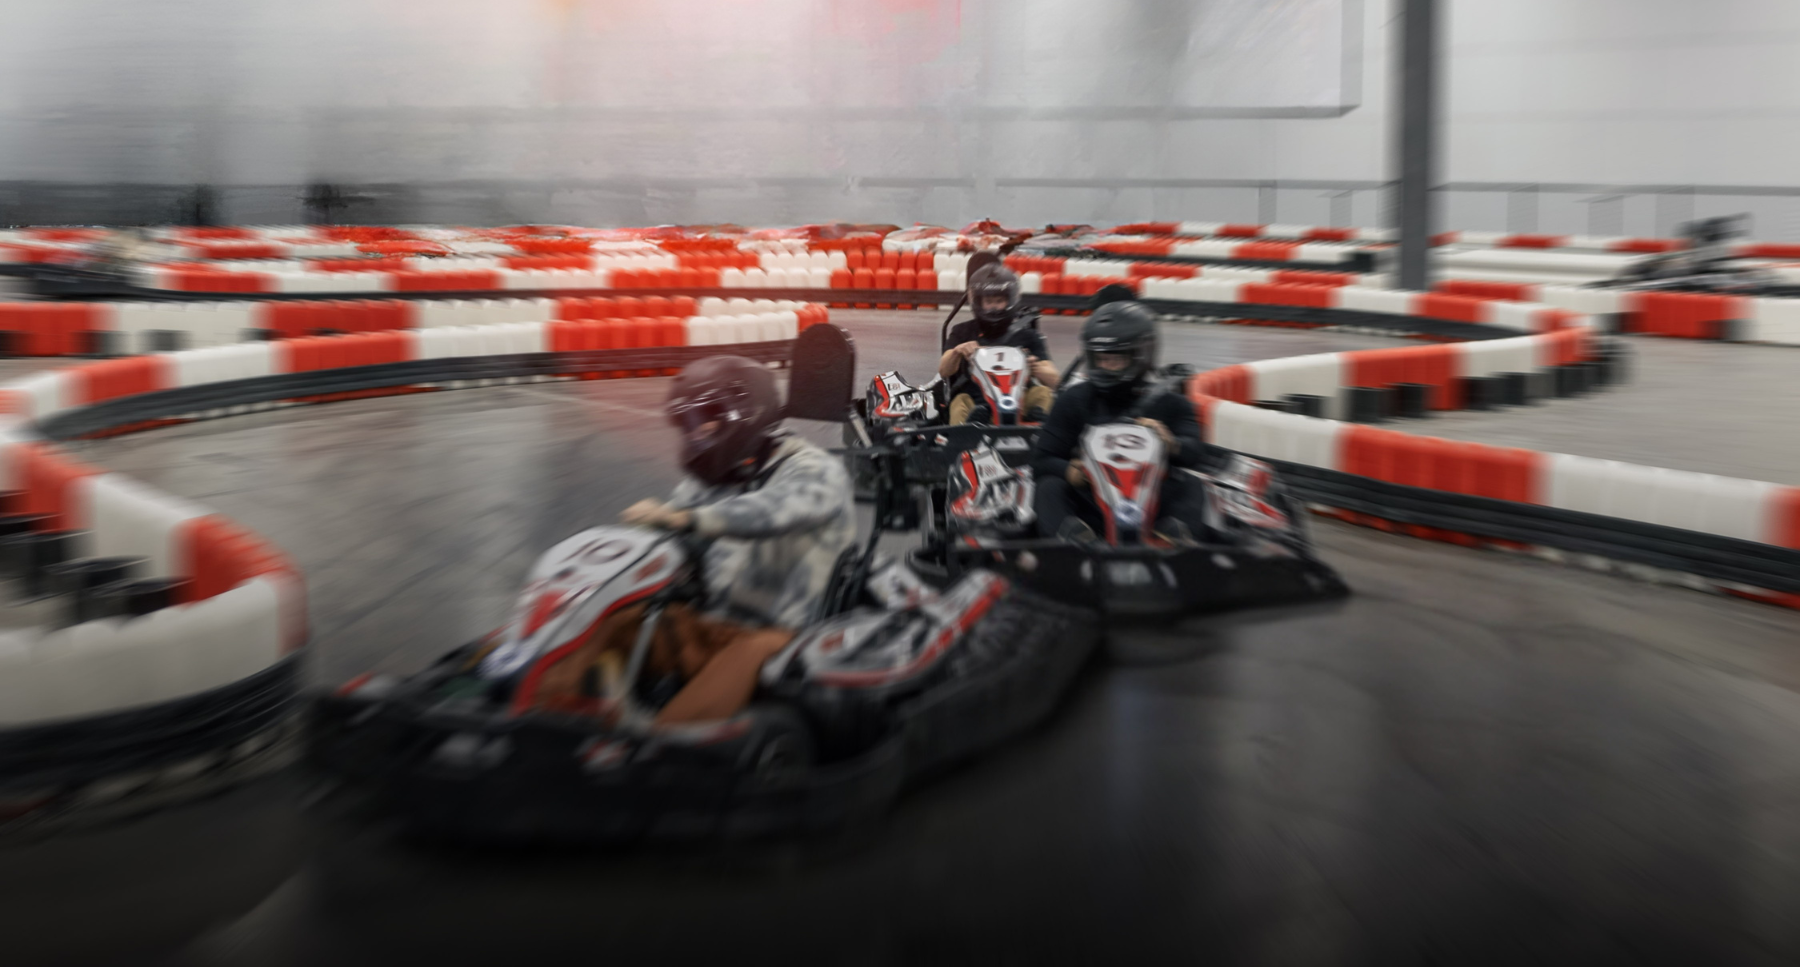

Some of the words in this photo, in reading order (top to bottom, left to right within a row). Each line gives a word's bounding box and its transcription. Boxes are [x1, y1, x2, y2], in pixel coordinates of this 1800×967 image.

[994, 352, 1005, 362] 1
[1102, 433, 1146, 450] 13
[557, 537, 633, 565] 10
